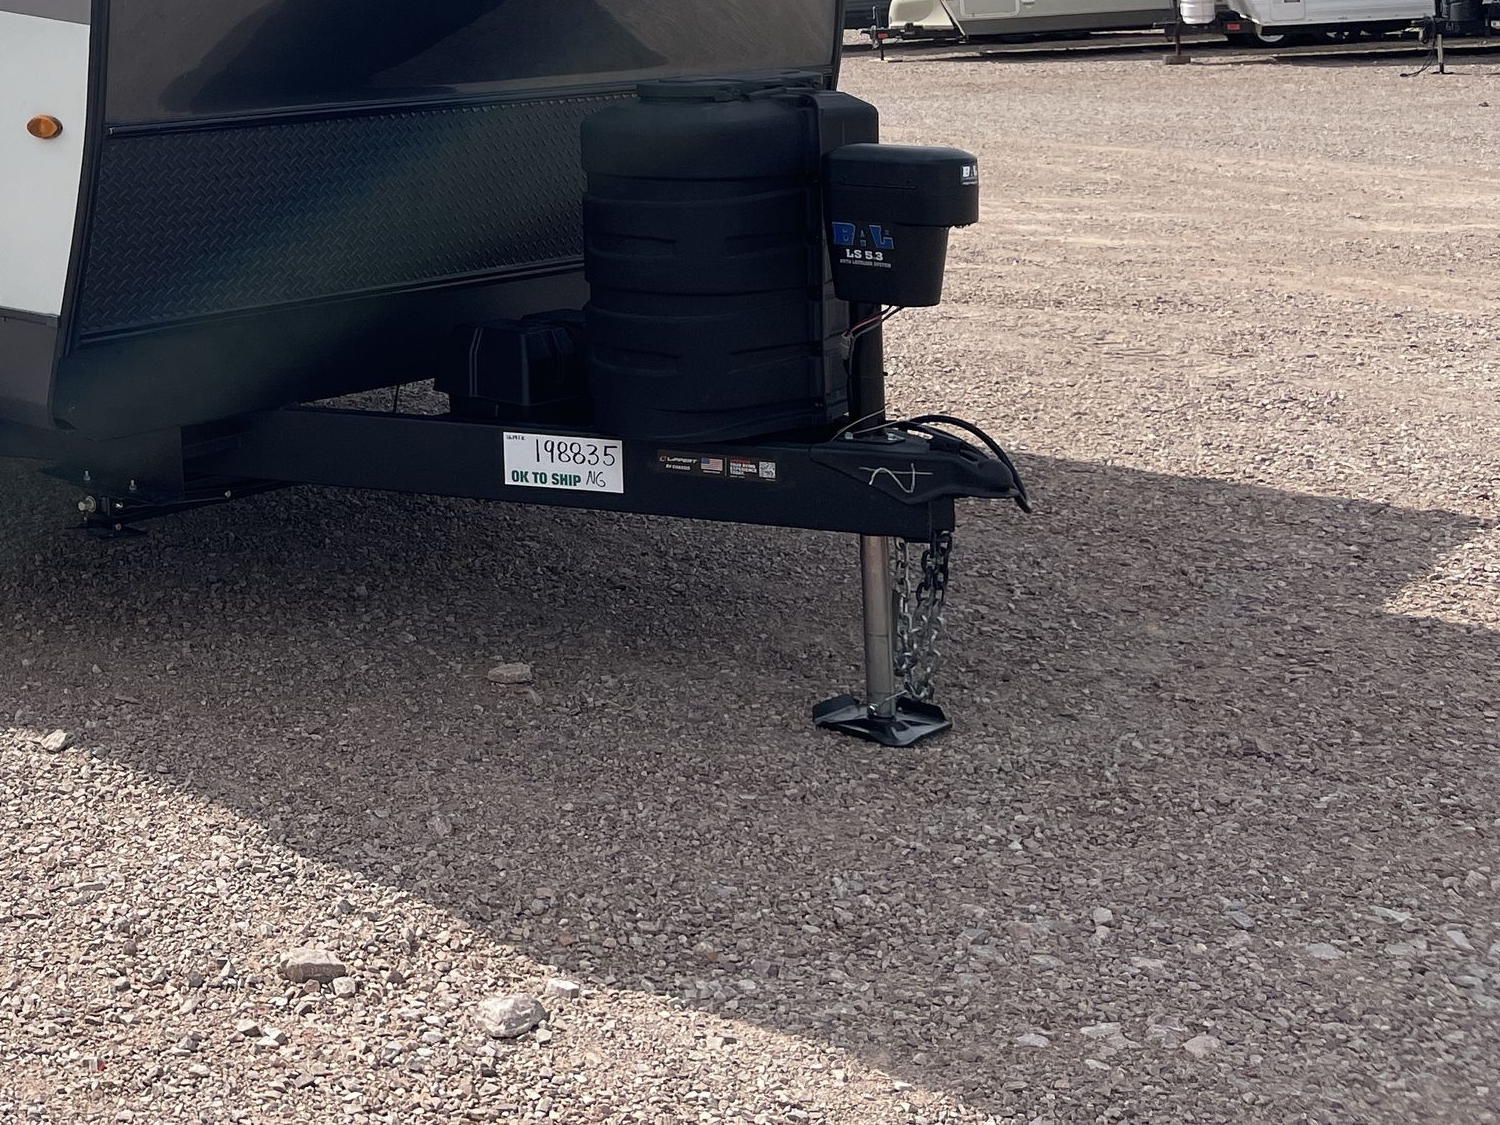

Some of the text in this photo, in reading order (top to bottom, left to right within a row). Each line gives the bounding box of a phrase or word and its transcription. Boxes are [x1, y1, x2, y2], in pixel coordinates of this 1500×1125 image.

[845, 248, 862, 259] LS
[536, 439, 618, 466] 198835
[511, 470, 582, 486] OK TO SHIP
